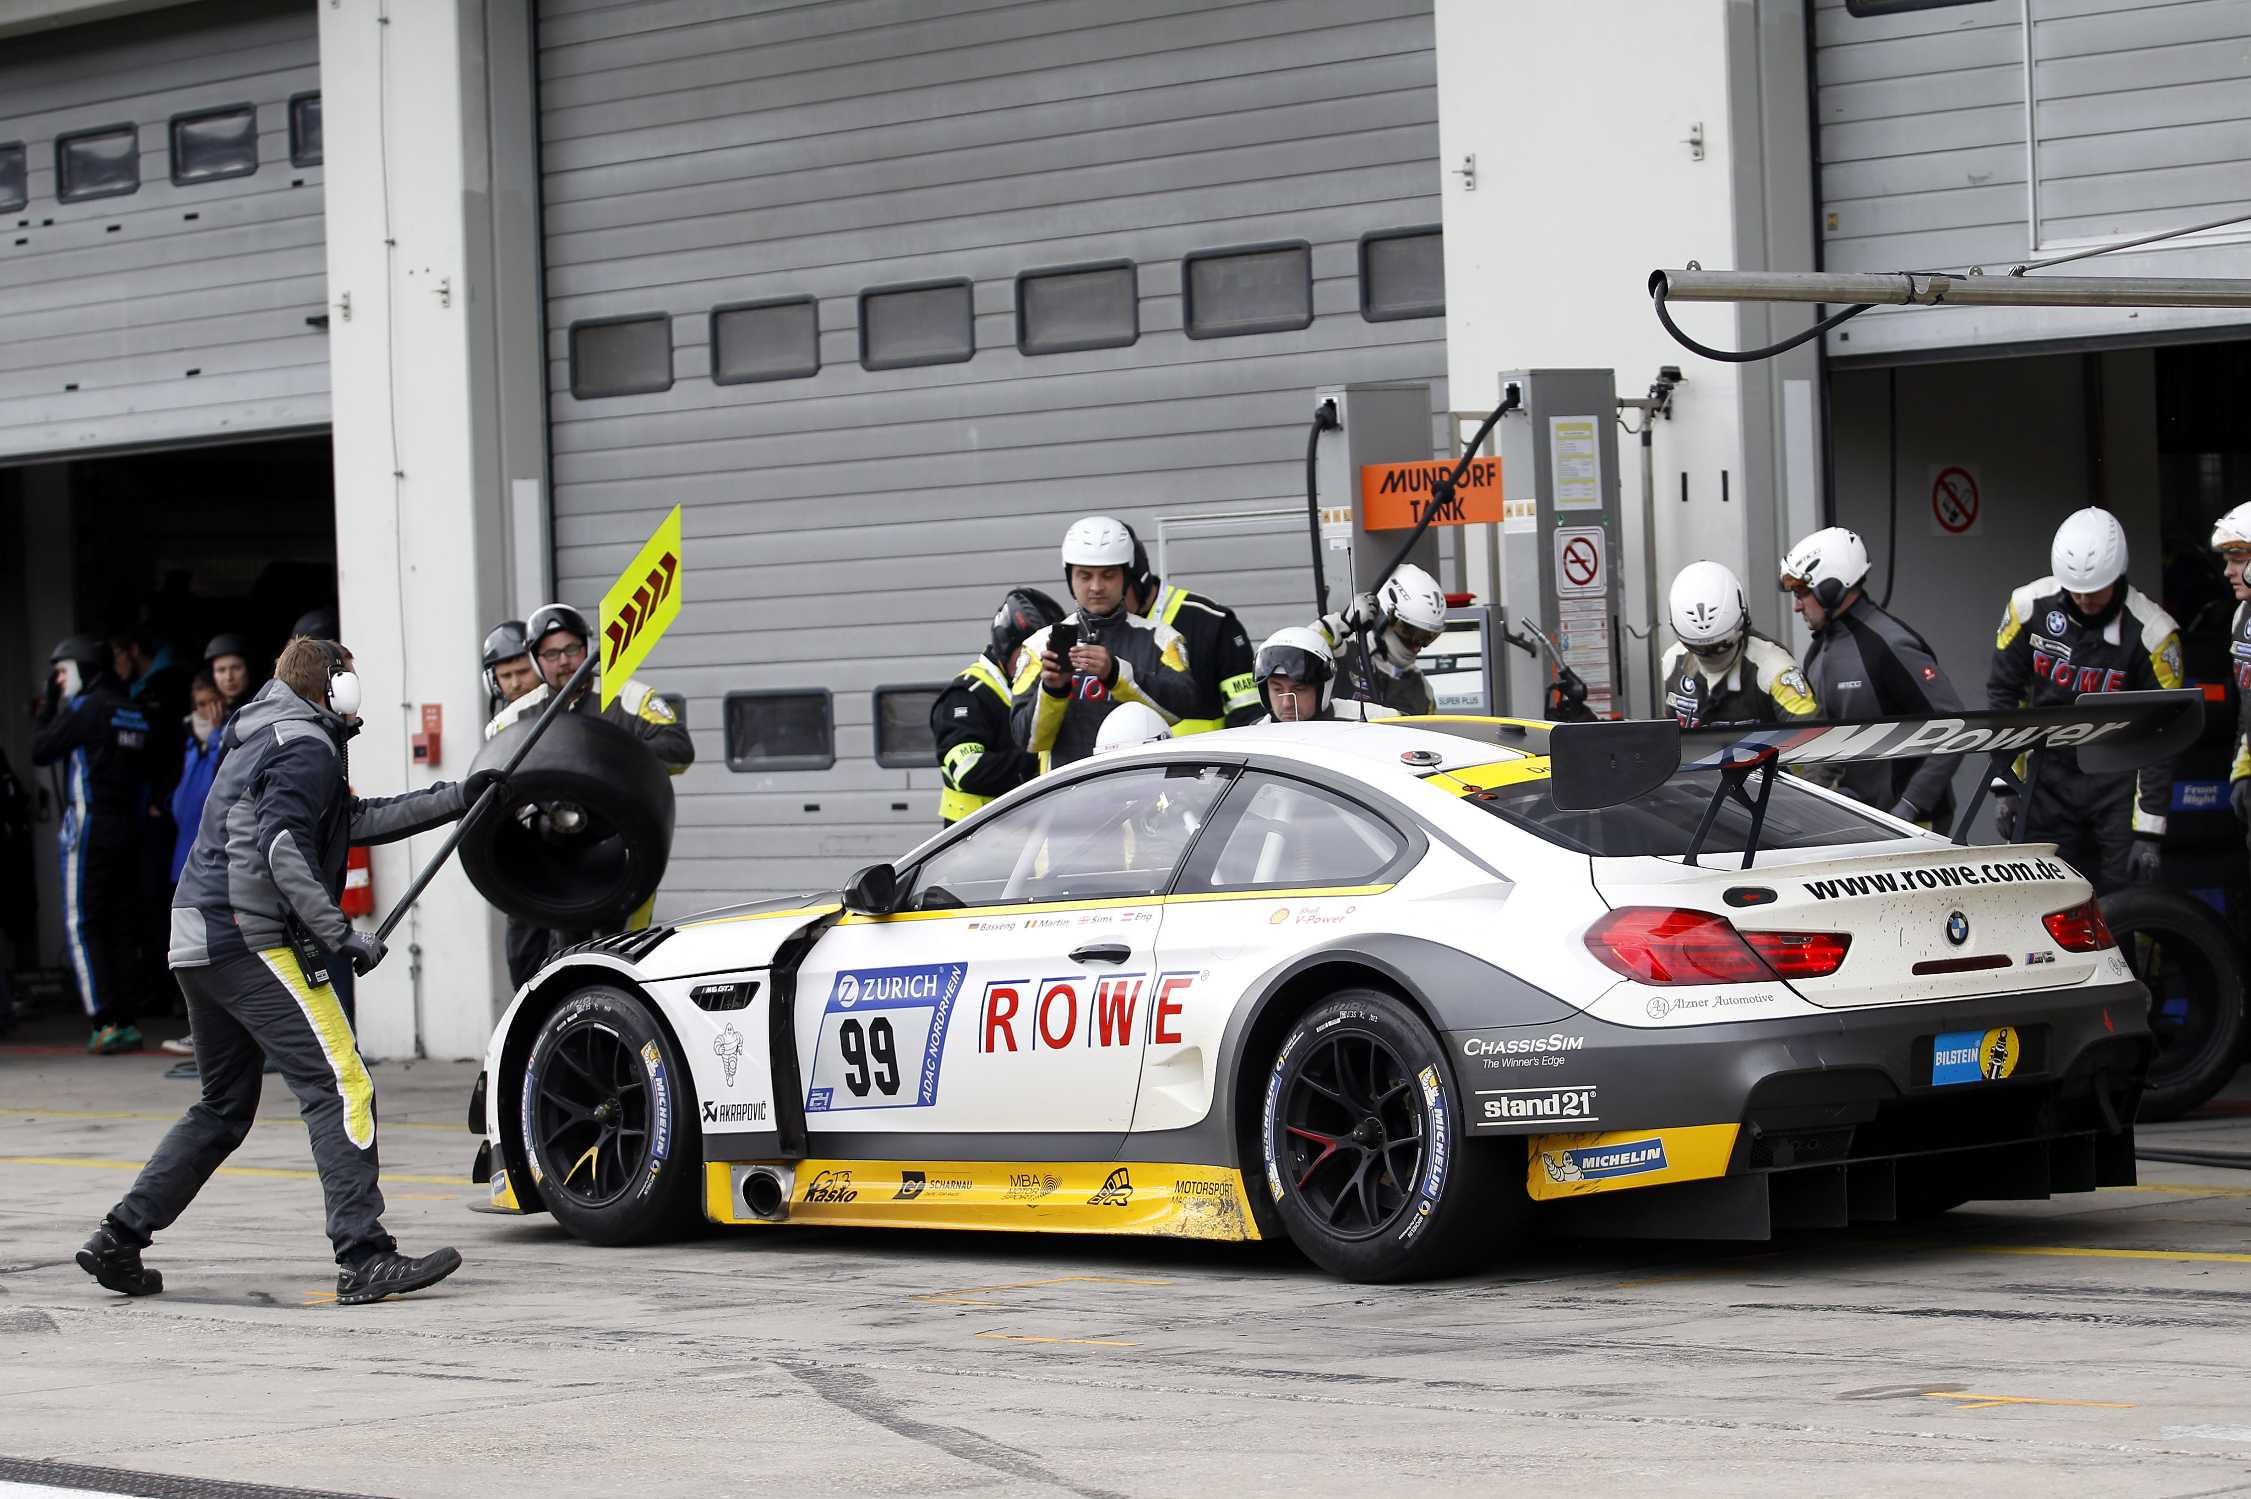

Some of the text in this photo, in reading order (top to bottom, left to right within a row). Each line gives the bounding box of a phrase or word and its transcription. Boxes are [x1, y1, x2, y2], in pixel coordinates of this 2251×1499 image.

[2033, 650, 2130, 694] ROWE
[1438, 695, 1479, 705] SUPER PLUS
[1876, 718, 2131, 759] Power
[1803, 857, 2066, 901] www.rowe.com.de
[1039, 919, 1070, 929] Martin
[1091, 915, 1113, 925] Sims
[1134, 911, 1153, 922] Eng
[862, 974, 938, 1001] ZURICH
[1669, 998, 1710, 1012] Alzner
[1711, 993, 1774, 1008] Automotive
[978, 972, 1200, 1054] ROWE
[922, 965, 962, 1104] ADAC NORDRHEIN
[839, 1017, 901, 1098] 99
[1482, 1055, 1566, 1069] The Winner's Edge
[1935, 1047, 1979, 1066] BILSTEIN
[1484, 1091, 1590, 1119] stand21
[655, 1077, 669, 1154] MICHELIN
[1428, 1108, 1446, 1196] MICHELIN
[1582, 1147, 1661, 1169] MICHELIN
[930, 1179, 973, 1190] SCHARNAU
[1009, 1174, 1041, 1187] MBA
[1174, 1180, 1233, 1195] MOTORSPORT
[803, 1185, 858, 1202] Kasko
